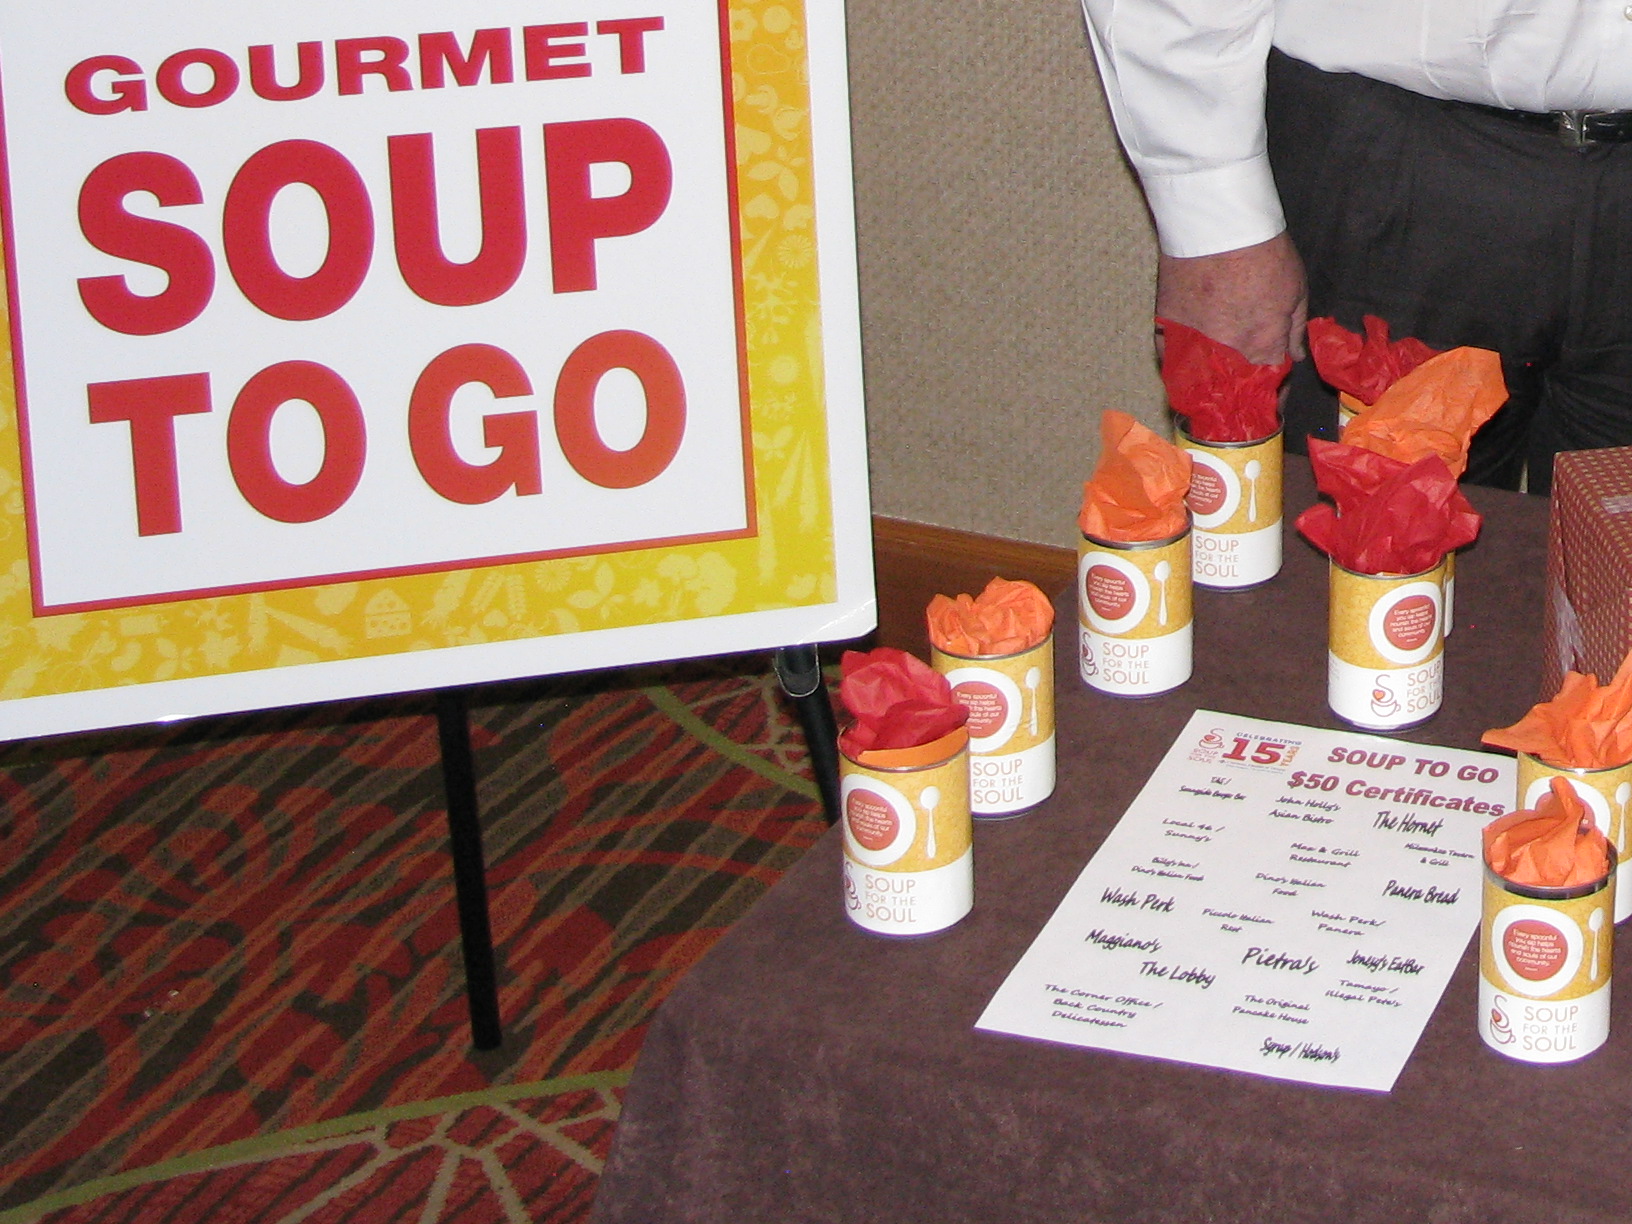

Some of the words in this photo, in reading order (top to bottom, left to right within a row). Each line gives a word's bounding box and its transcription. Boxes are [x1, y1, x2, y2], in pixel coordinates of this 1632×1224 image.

[65, 16, 664, 115] GOURMET
[76, 117, 673, 335] SOUP
[87, 360, 366, 536] TO
[408, 329, 686, 505] GO
[1195, 536, 1239, 552] SOUP
[1195, 561, 1238, 578] SOUL
[1102, 642, 1149, 658] SOUP
[1103, 668, 1149, 685] SOUL
[1222, 737, 1286, 764] 15
[973, 759, 1022, 776] SOUP
[1327, 747, 1406, 770] SOUP
[1414, 759, 1450, 777] TO
[1457, 765, 1499, 784] GO
[974, 787, 1024, 804] SOUL
[1287, 771, 1339, 791] $50
[1346, 780, 1505, 817] Certificates
[1269, 809, 1300, 819] Asian
[1302, 814, 1334, 824] Bistro
[1372, 810, 1396, 830] The
[1397, 811, 1444, 837] Hornet
[865, 874, 916, 894] SOUP
[1100, 887, 1140, 907] Wash
[1140, 894, 1175, 912] Perk
[866, 903, 916, 922] SOUL
[1311, 910, 1346, 921] Wash
[1085, 929, 1163, 953] Maggiano's
[1242, 947, 1320, 975] Pietra's
[1139, 961, 1169, 977] The
[1169, 965, 1216, 989] Lobby
[1045, 983, 1068, 993] The
[1070, 989, 1113, 1001] Corner
[1053, 998, 1084, 1009] Back
[1086, 1004, 1137, 1018] Country
[1245, 995, 1263, 1003] The
[1266, 998, 1310, 1011] Original
[1052, 1010, 1127, 1027] Delicatessen
[1232, 1006, 1277, 1018] Pancake
[1278, 1013, 1309, 1024] House
[1524, 1006, 1579, 1022] SOUP
[1523, 1035, 1576, 1052] SOUL
